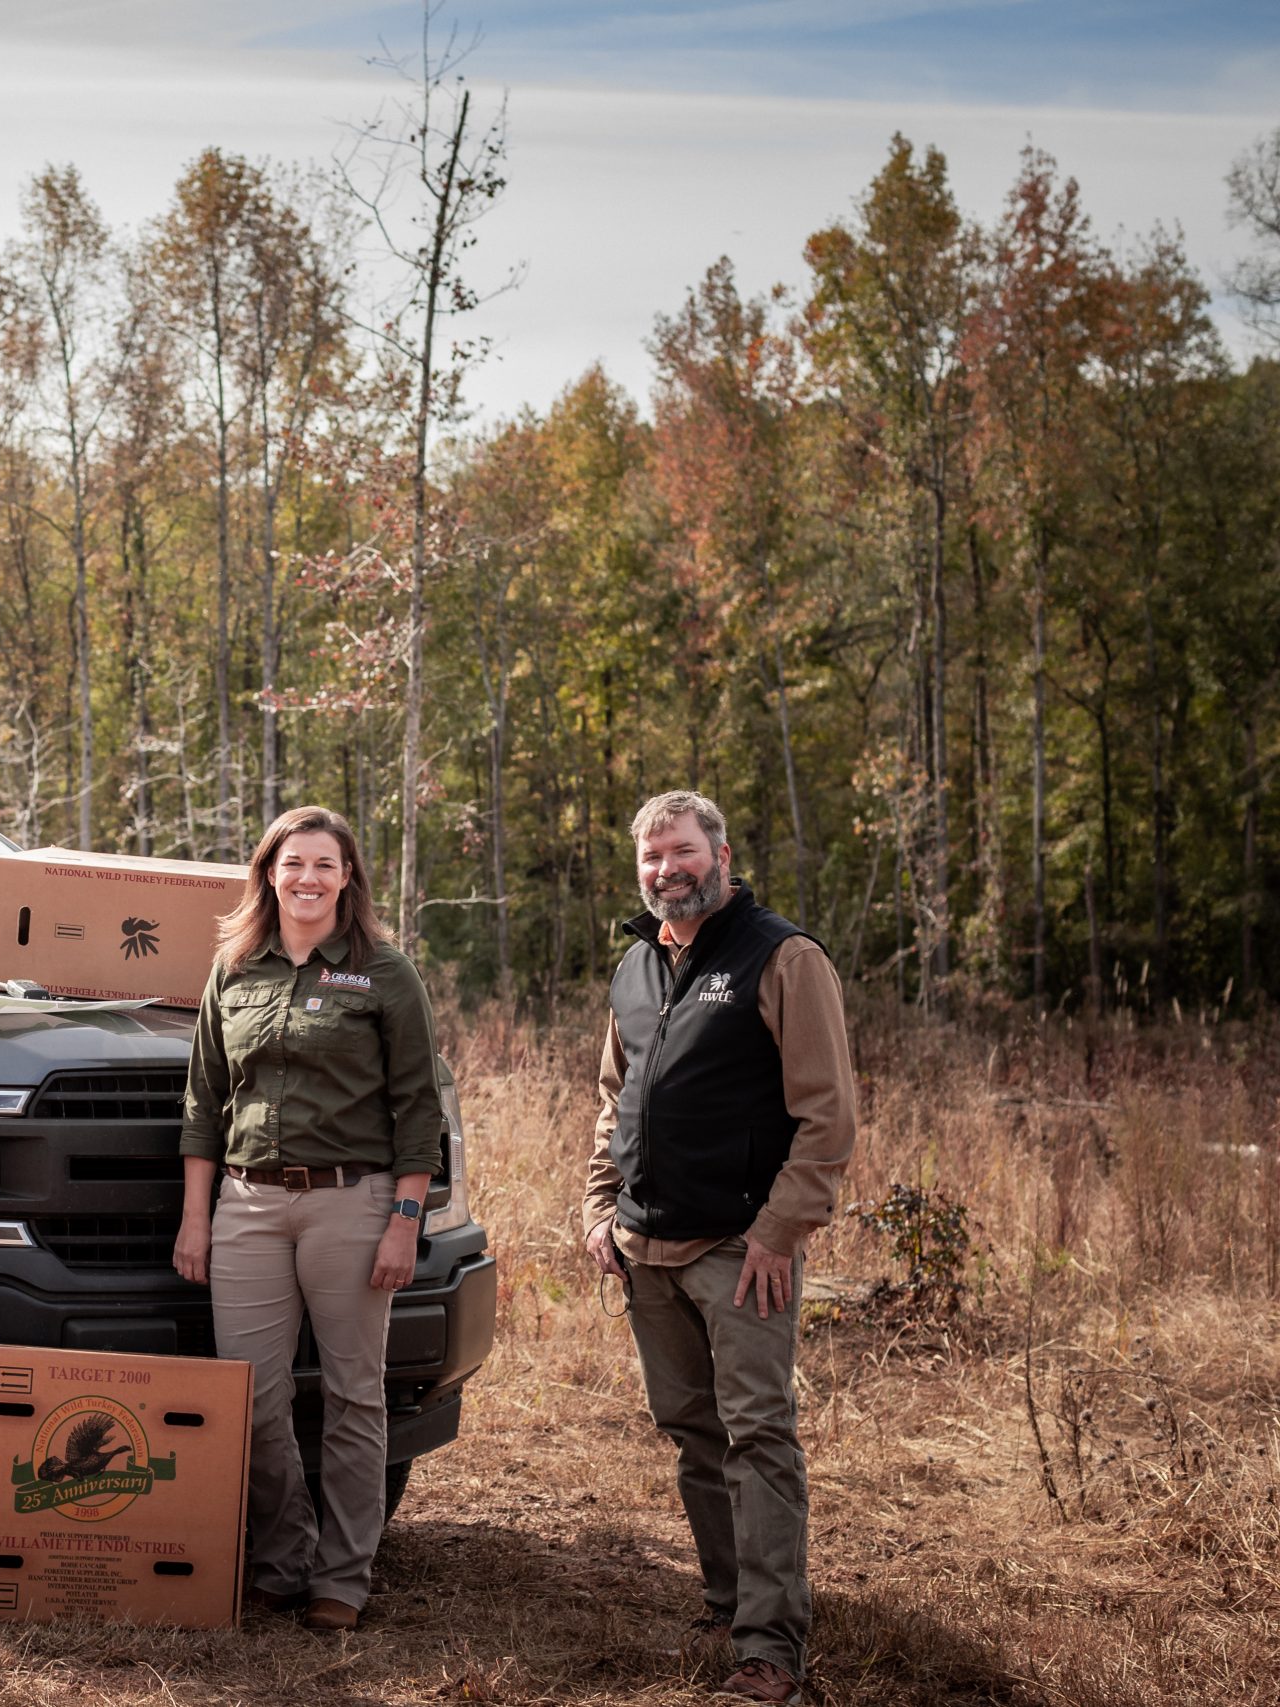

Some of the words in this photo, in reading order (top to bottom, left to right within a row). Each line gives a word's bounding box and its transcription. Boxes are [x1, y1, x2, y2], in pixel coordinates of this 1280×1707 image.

[45, 867, 93, 879] NATIONAL
[96, 871, 121, 882] WILD
[124, 873, 163, 885] TURKEY
[165, 877, 226, 890] FEDERATION
[331, 973, 370, 984] GEORGIA
[41, 984, 96, 997] FEDERATIO
[98, 989, 137, 1000] TURKEY
[167, 996, 201, 1006] TIONAL
[48, 1366, 114, 1384] TARGET
[119, 1370, 151, 1385] 2000
[36, 1414, 61, 1453] National
[61, 1400, 82, 1414] Wild
[85, 1399, 117, 1413] Turkey
[118, 1409, 144, 1458] Federation
[52, 1475, 147, 1503] Anniversary
[40, 1531, 65, 1539] PRIMARY
[99, 1539, 186, 1555] INDUSTRIES
